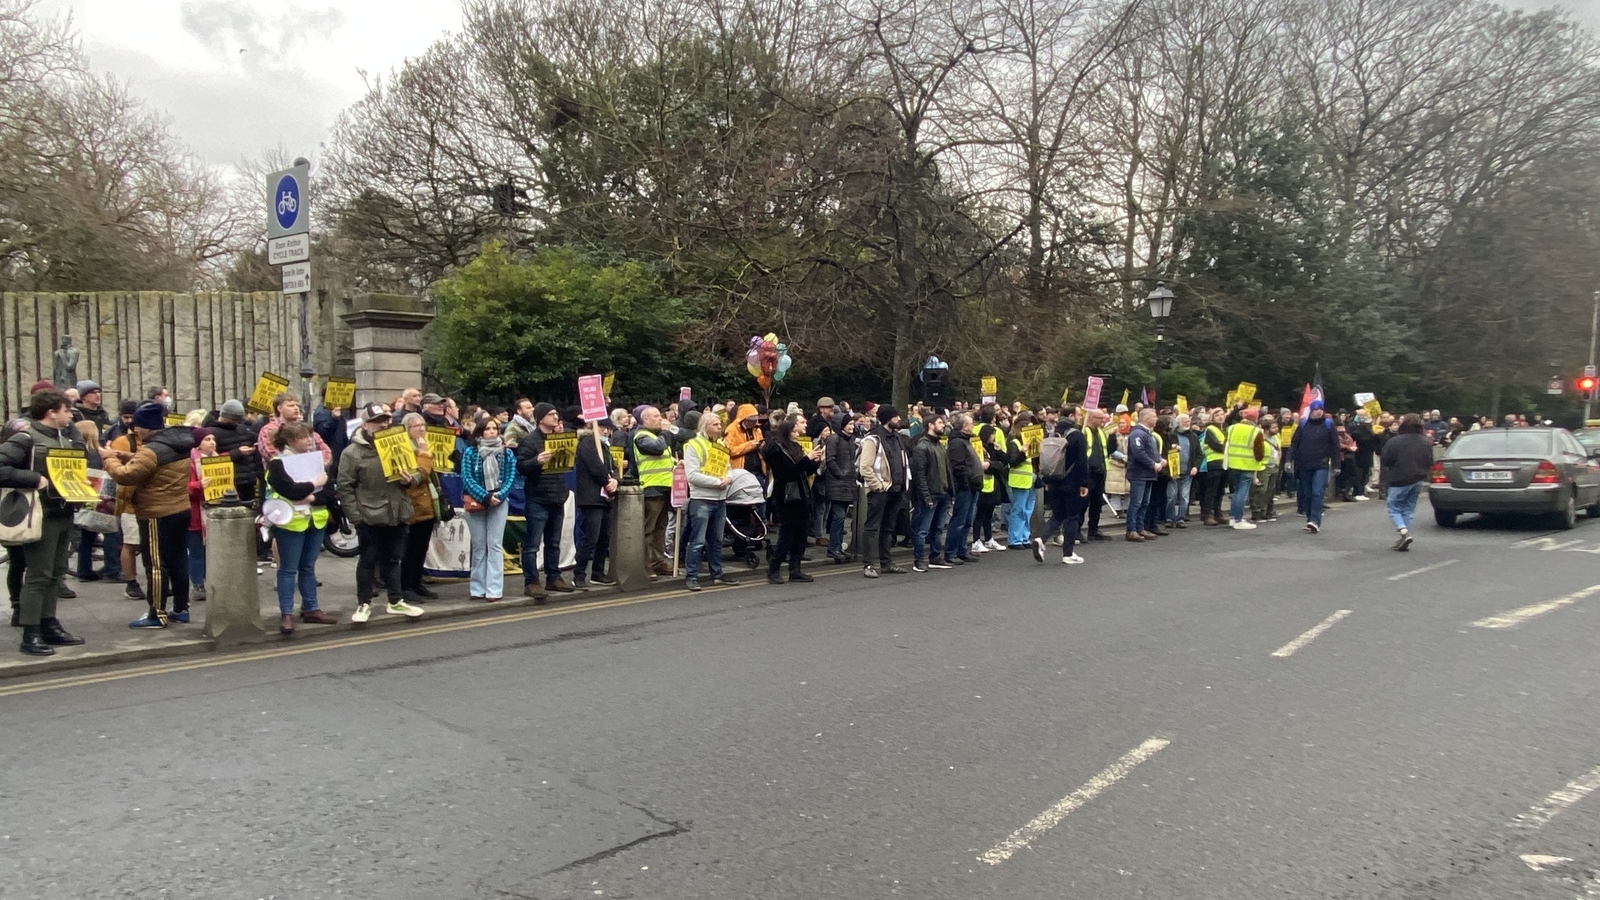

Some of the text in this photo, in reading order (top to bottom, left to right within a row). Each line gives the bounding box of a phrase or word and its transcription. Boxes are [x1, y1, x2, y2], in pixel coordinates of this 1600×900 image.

[273, 247, 304, 260] CYCLE TRACK
[378, 433, 407, 449] HOUSING
[427, 433, 452, 445] HOUSING
[548, 439, 574, 449] HOUSING
[50, 458, 82, 470] HOUSING
[204, 466, 231, 477] REFUGEES
